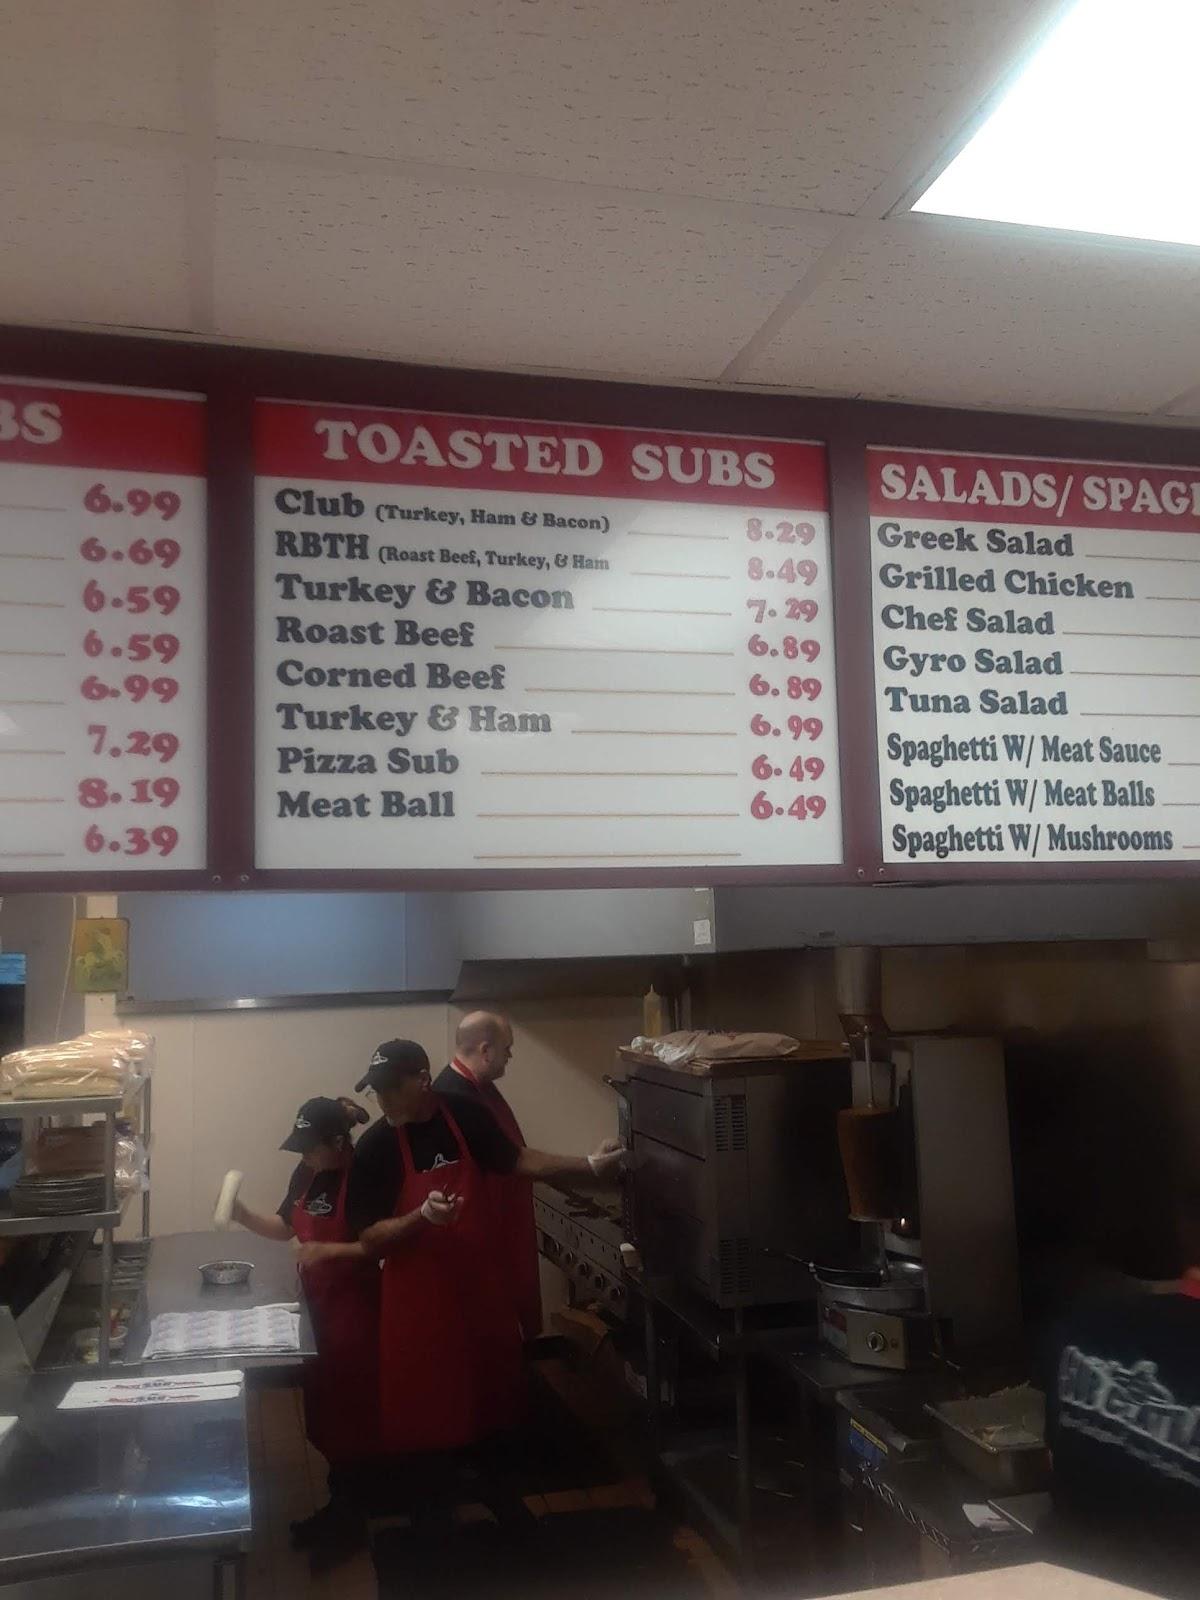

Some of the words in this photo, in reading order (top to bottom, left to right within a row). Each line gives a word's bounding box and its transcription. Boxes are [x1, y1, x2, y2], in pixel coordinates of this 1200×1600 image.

[315, 420, 603, 476] TOASTED
[631, 445, 775, 489] SUBS
[83, 484, 181, 520] 6.99
[275, 488, 365, 518] Club
[375, 504, 464, 526] (Turkey,
[470, 509, 516, 526] Ham
[521, 511, 537, 526] &
[542, 512, 610, 534] Bacon)
[746, 518, 816, 545] 8.29
[877, 523, 979, 553] Greek
[985, 527, 1074, 557] Salad
[81, 537, 181, 567] 6.69
[275, 531, 369, 560] RBTH
[378, 546, 434, 564] (Roast
[439, 549, 481, 567] Beef,
[485, 550, 550, 570] Turkey,
[554, 553, 568, 568] &
[572, 554, 610, 570] Ham
[747, 557, 818, 585] 8.49
[878, 563, 996, 593] Grilled
[1004, 568, 1134, 599] Chicken
[83, 580, 181, 615] 6.59
[276, 573, 416, 609] Turkey
[426, 578, 457, 606] &
[466, 580, 575, 609] Bacon
[747, 598, 818, 623] 7.29
[880, 604, 958, 632] Chef
[966, 607, 1055, 635] Salad
[83, 629, 181, 663] 6.59
[276, 616, 384, 645] Roast
[394, 620, 475, 648] Beef
[747, 634, 820, 662] 6.89
[276, 660, 416, 688] Corned
[426, 663, 506, 690] Beef
[882, 645, 966, 677] Gyro
[974, 647, 1063, 675] Salad
[81, 675, 179, 702] 6.99
[748, 673, 822, 701] 6.89
[884, 687, 970, 714] Tuna
[979, 689, 1068, 715] Salad
[276, 702, 418, 737] Turkey
[428, 704, 458, 730] &
[469, 706, 552, 733] Ham
[750, 714, 823, 741] 6.99
[87, 725, 179, 762] 7.29
[886, 733, 998, 767] Spaghetti
[1002, 734, 1034, 768] W/
[1041, 736, 1094, 763] Meat
[1099, 737, 1162, 763] Sauce
[277, 746, 378, 774] Pizza
[386, 748, 459, 774] Sub
[751, 754, 825, 782] 6.49
[78, 777, 180, 810] 8.19
[277, 790, 370, 818] Meat
[380, 790, 456, 818] Ball
[750, 791, 826, 821] 6.49
[889, 778, 1000, 811] Spaghetti
[1005, 778, 1038, 813] W/
[1043, 779, 1097, 806] Meat
[1102, 778, 1155, 806] Balls
[83, 824, 180, 856] 6.39
[892, 823, 1004, 858] Spaghetti
[1008, 823, 1042, 857] W/
[1047, 823, 1174, 851] Mushrooms
